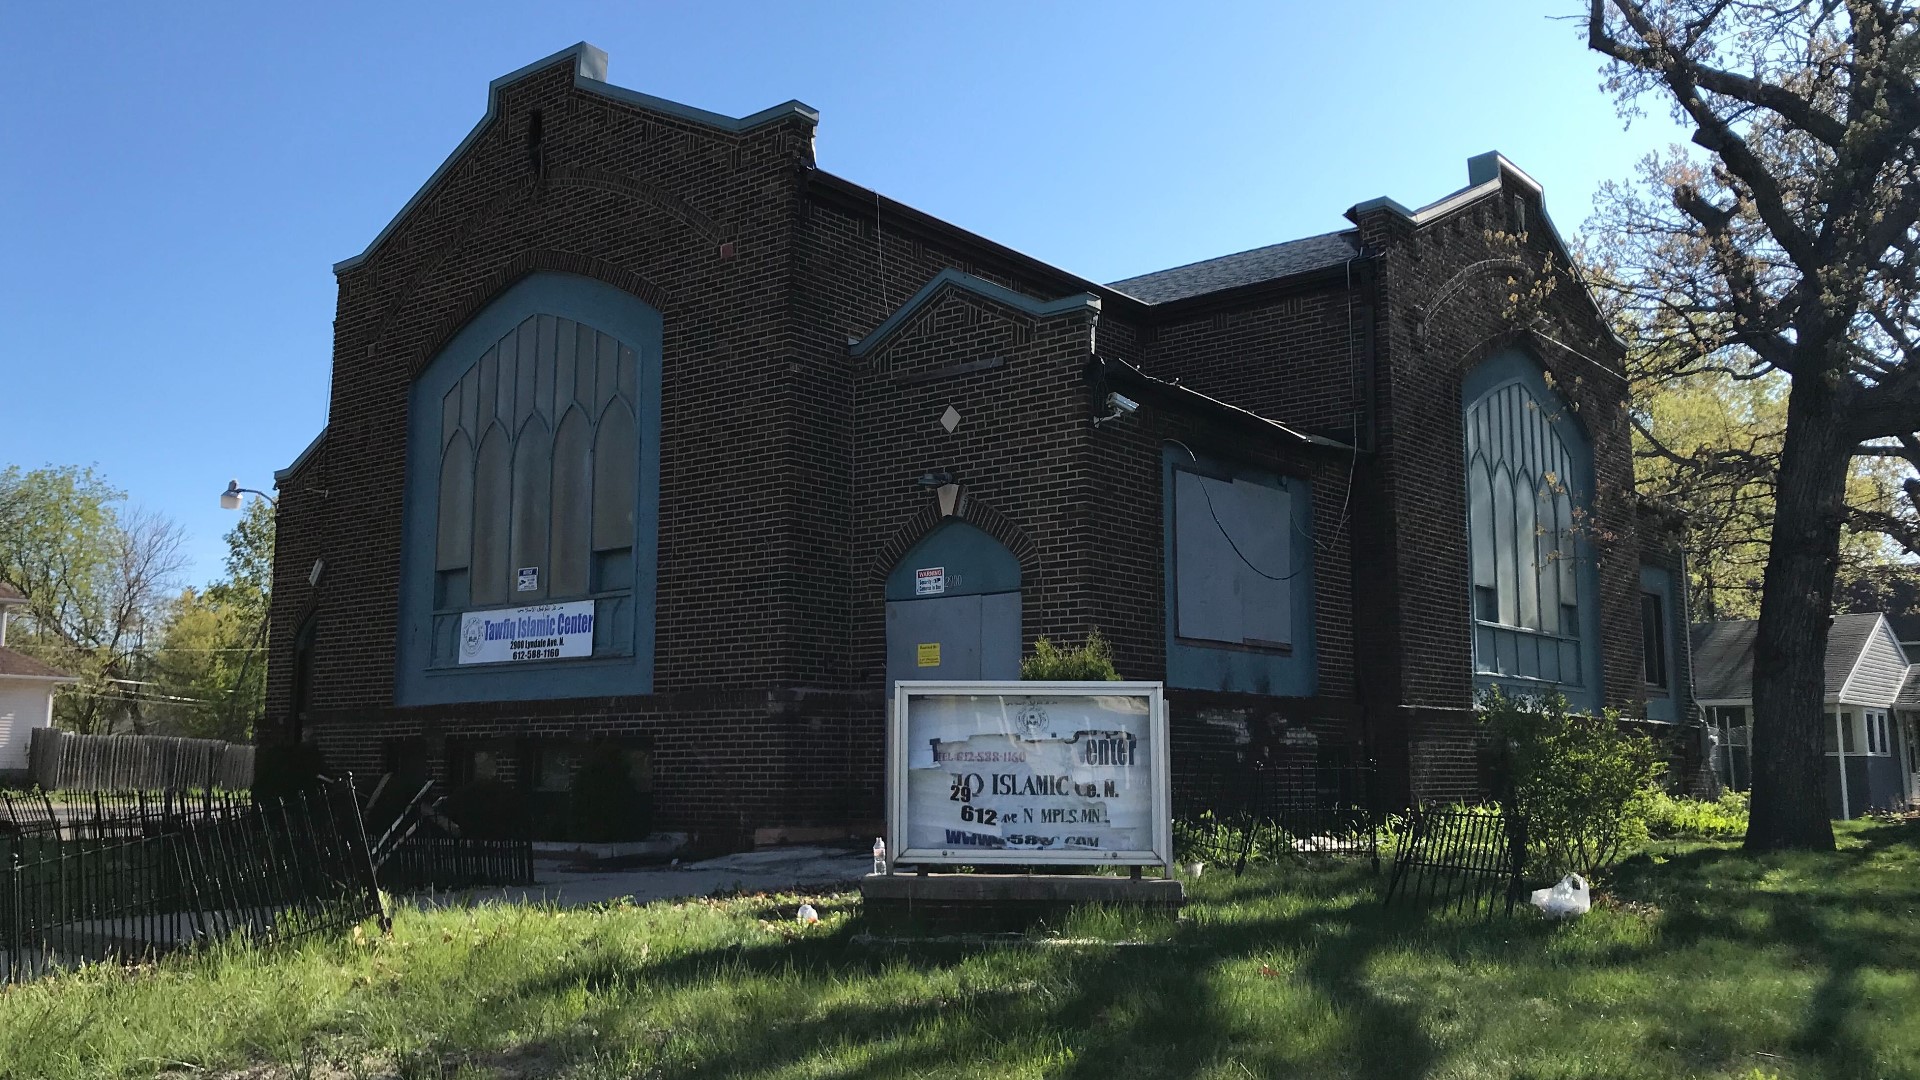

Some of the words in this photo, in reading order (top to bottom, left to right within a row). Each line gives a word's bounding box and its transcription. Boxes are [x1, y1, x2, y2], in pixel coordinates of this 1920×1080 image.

[919, 570, 942, 578] WARNING
[484, 618, 517, 641] Tawfiq
[517, 614, 556, 639] Islamic
[557, 613, 594, 636] Center
[510, 640, 524, 650] 2900
[525, 639, 546, 650] Lyndale
[547, 638, 558, 648] Ave.
[512, 648, 560, 660] 612-588-1160
[992, 774, 1069, 796] ISLAMIC
[961, 805, 998, 826] 612
[1023, 808, 1033, 824] N
